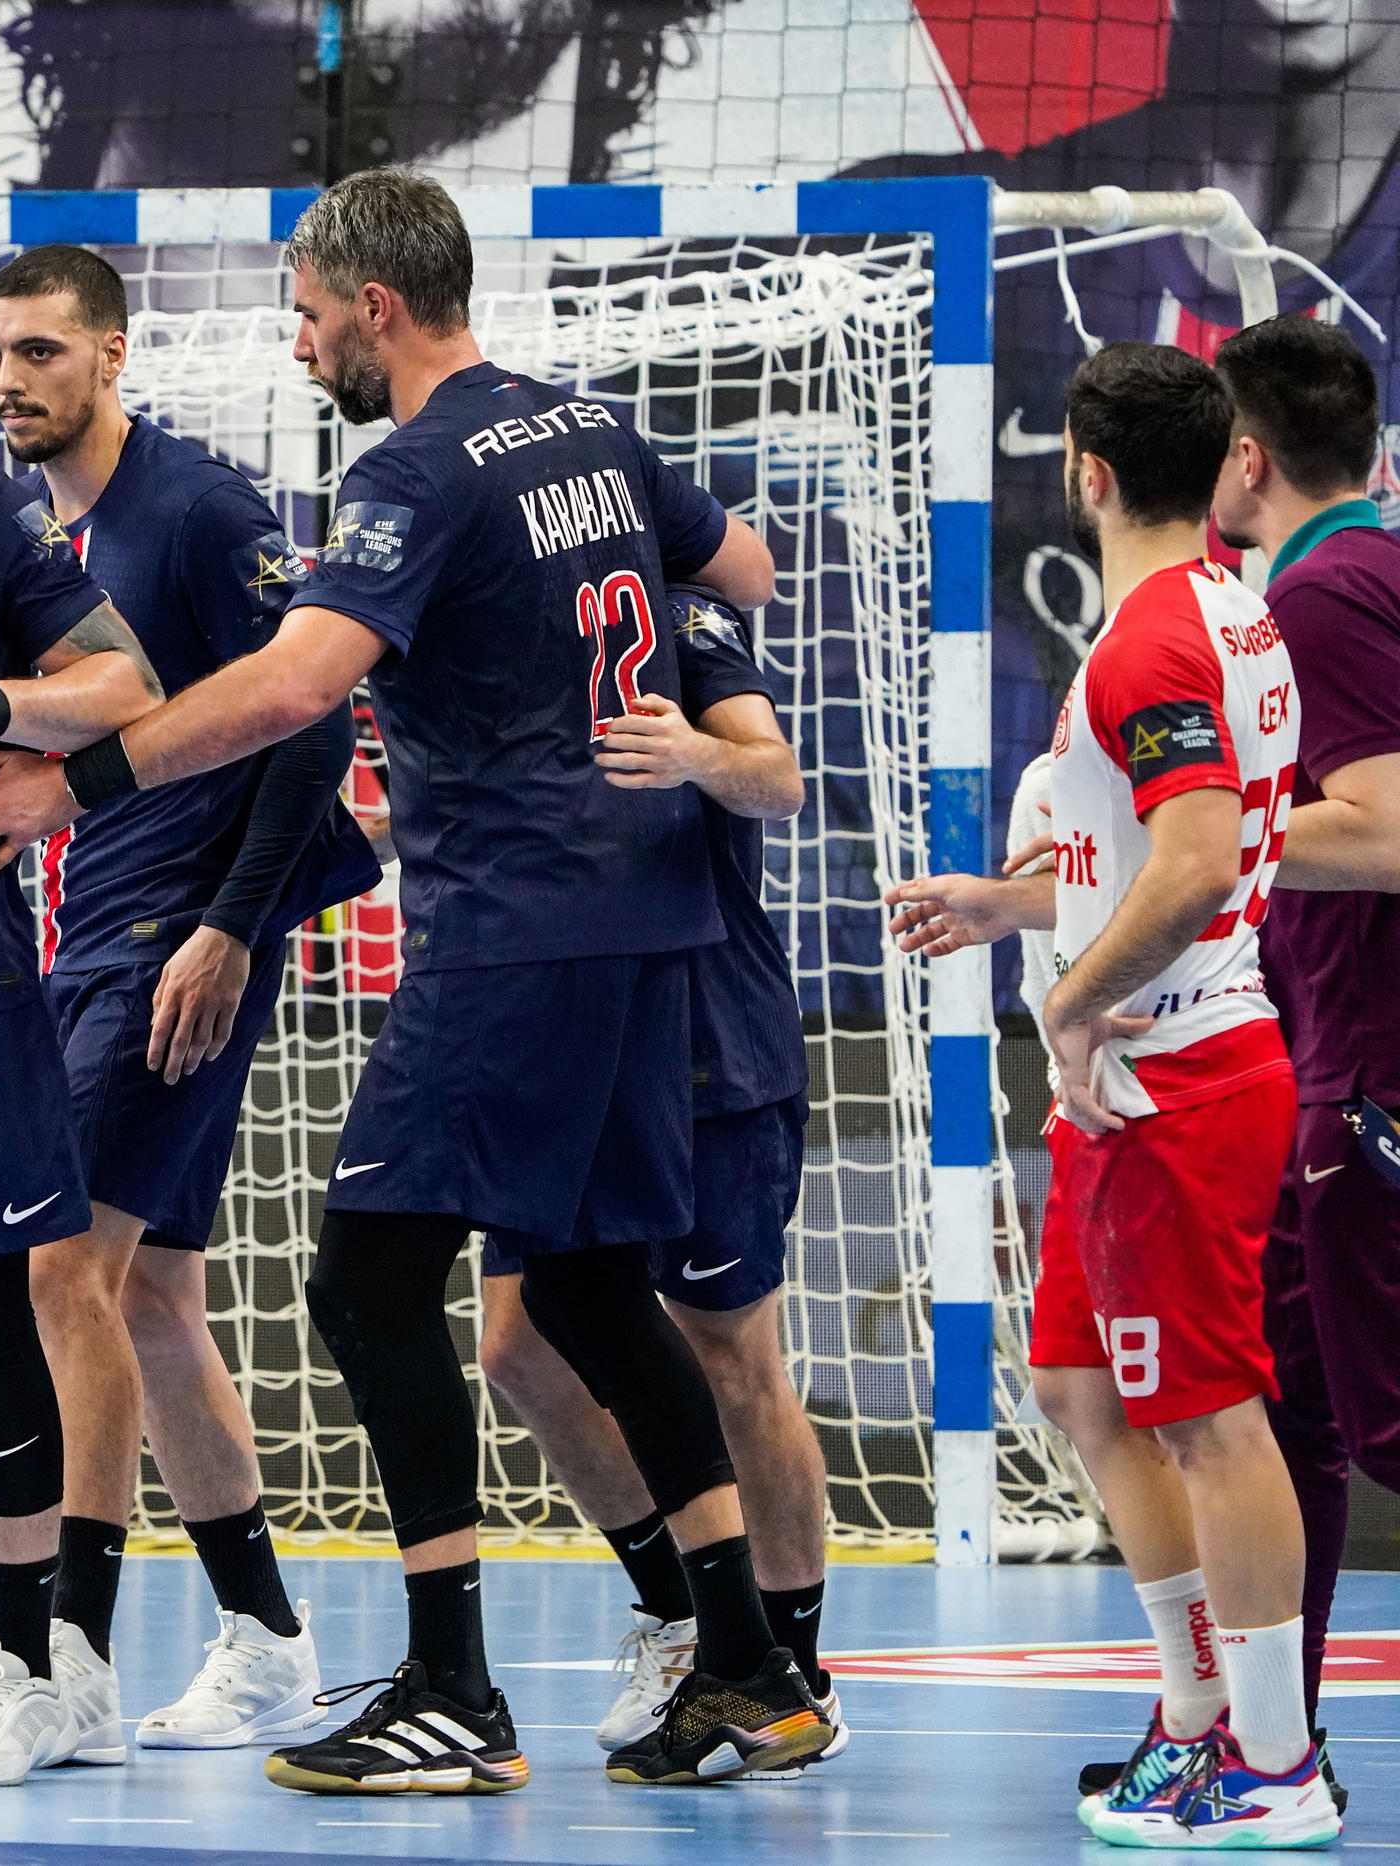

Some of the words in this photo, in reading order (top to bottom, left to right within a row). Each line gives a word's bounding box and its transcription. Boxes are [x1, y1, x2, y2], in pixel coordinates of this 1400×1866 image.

[463, 401, 619, 467] REUTER
[360, 529, 403, 548] CHAMPIONS
[365, 539, 393, 555] LEAGUE
[375, 520, 396, 529] EHF
[575, 568, 657, 743] 22
[1093, 1308, 1160, 1398] 8
[1188, 1600, 1220, 1681] Kempa
